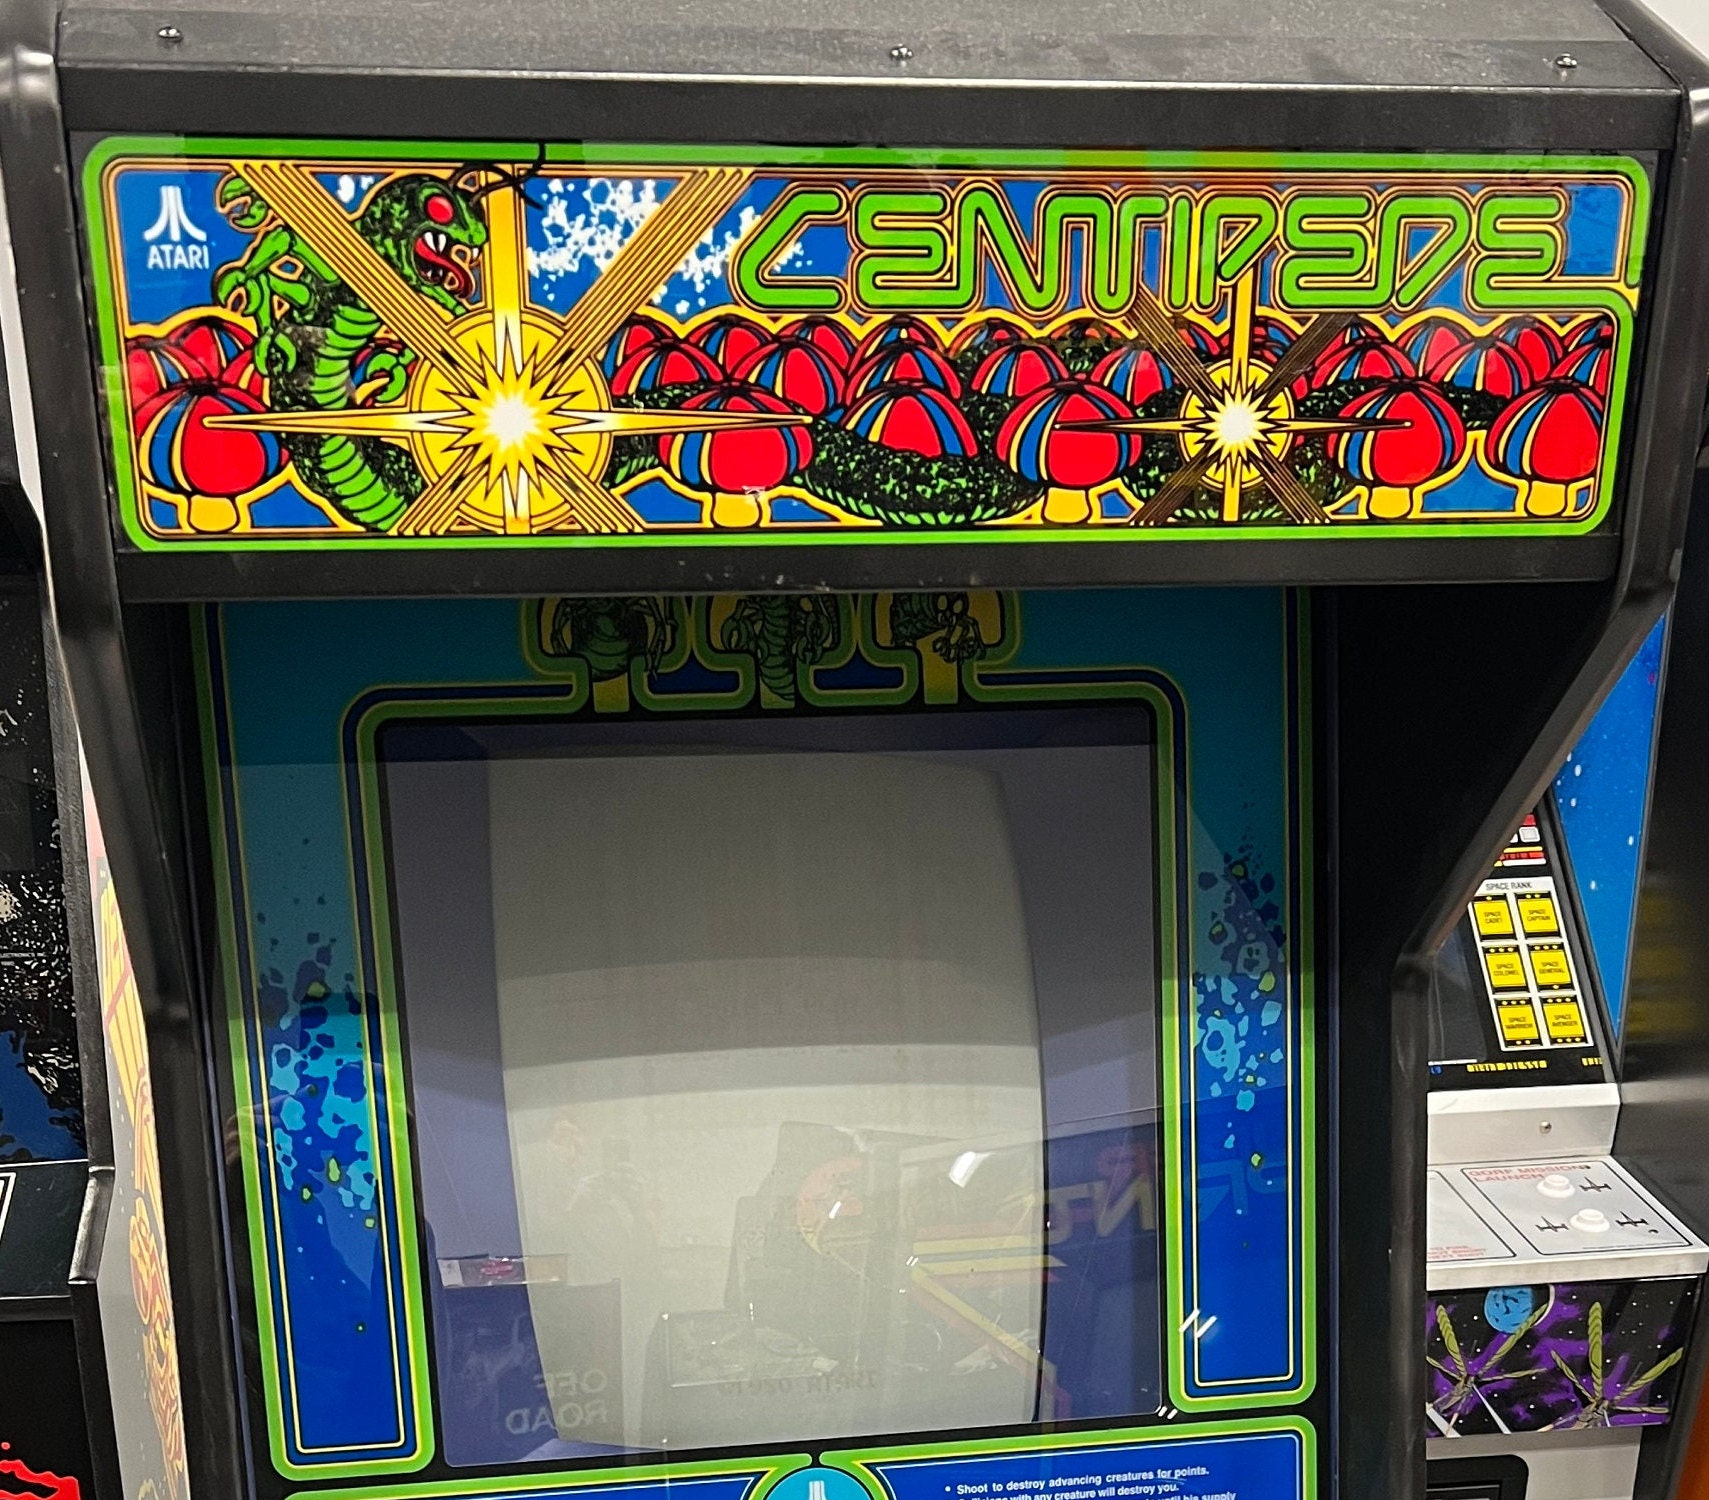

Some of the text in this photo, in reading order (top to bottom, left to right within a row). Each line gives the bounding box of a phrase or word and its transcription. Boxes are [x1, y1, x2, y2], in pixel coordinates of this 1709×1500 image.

[147, 244, 209, 269] ATARI
[734, 184, 1564, 314] CENTIPEDE
[1486, 881, 1532, 891] SPACE RANK
[1469, 1165, 1586, 1177] GORF MISSION
[1473, 1174, 1544, 1182] LAUNCH
[957, 1466, 1209, 1495] Shoot to destroy advancing creatures for points.
[1054, 1489, 1096, 1500] creature
[1098, 1487, 1115, 1497] will
[1118, 1484, 1155, 1496] destroy
[1158, 1484, 1179, 1494] you.
